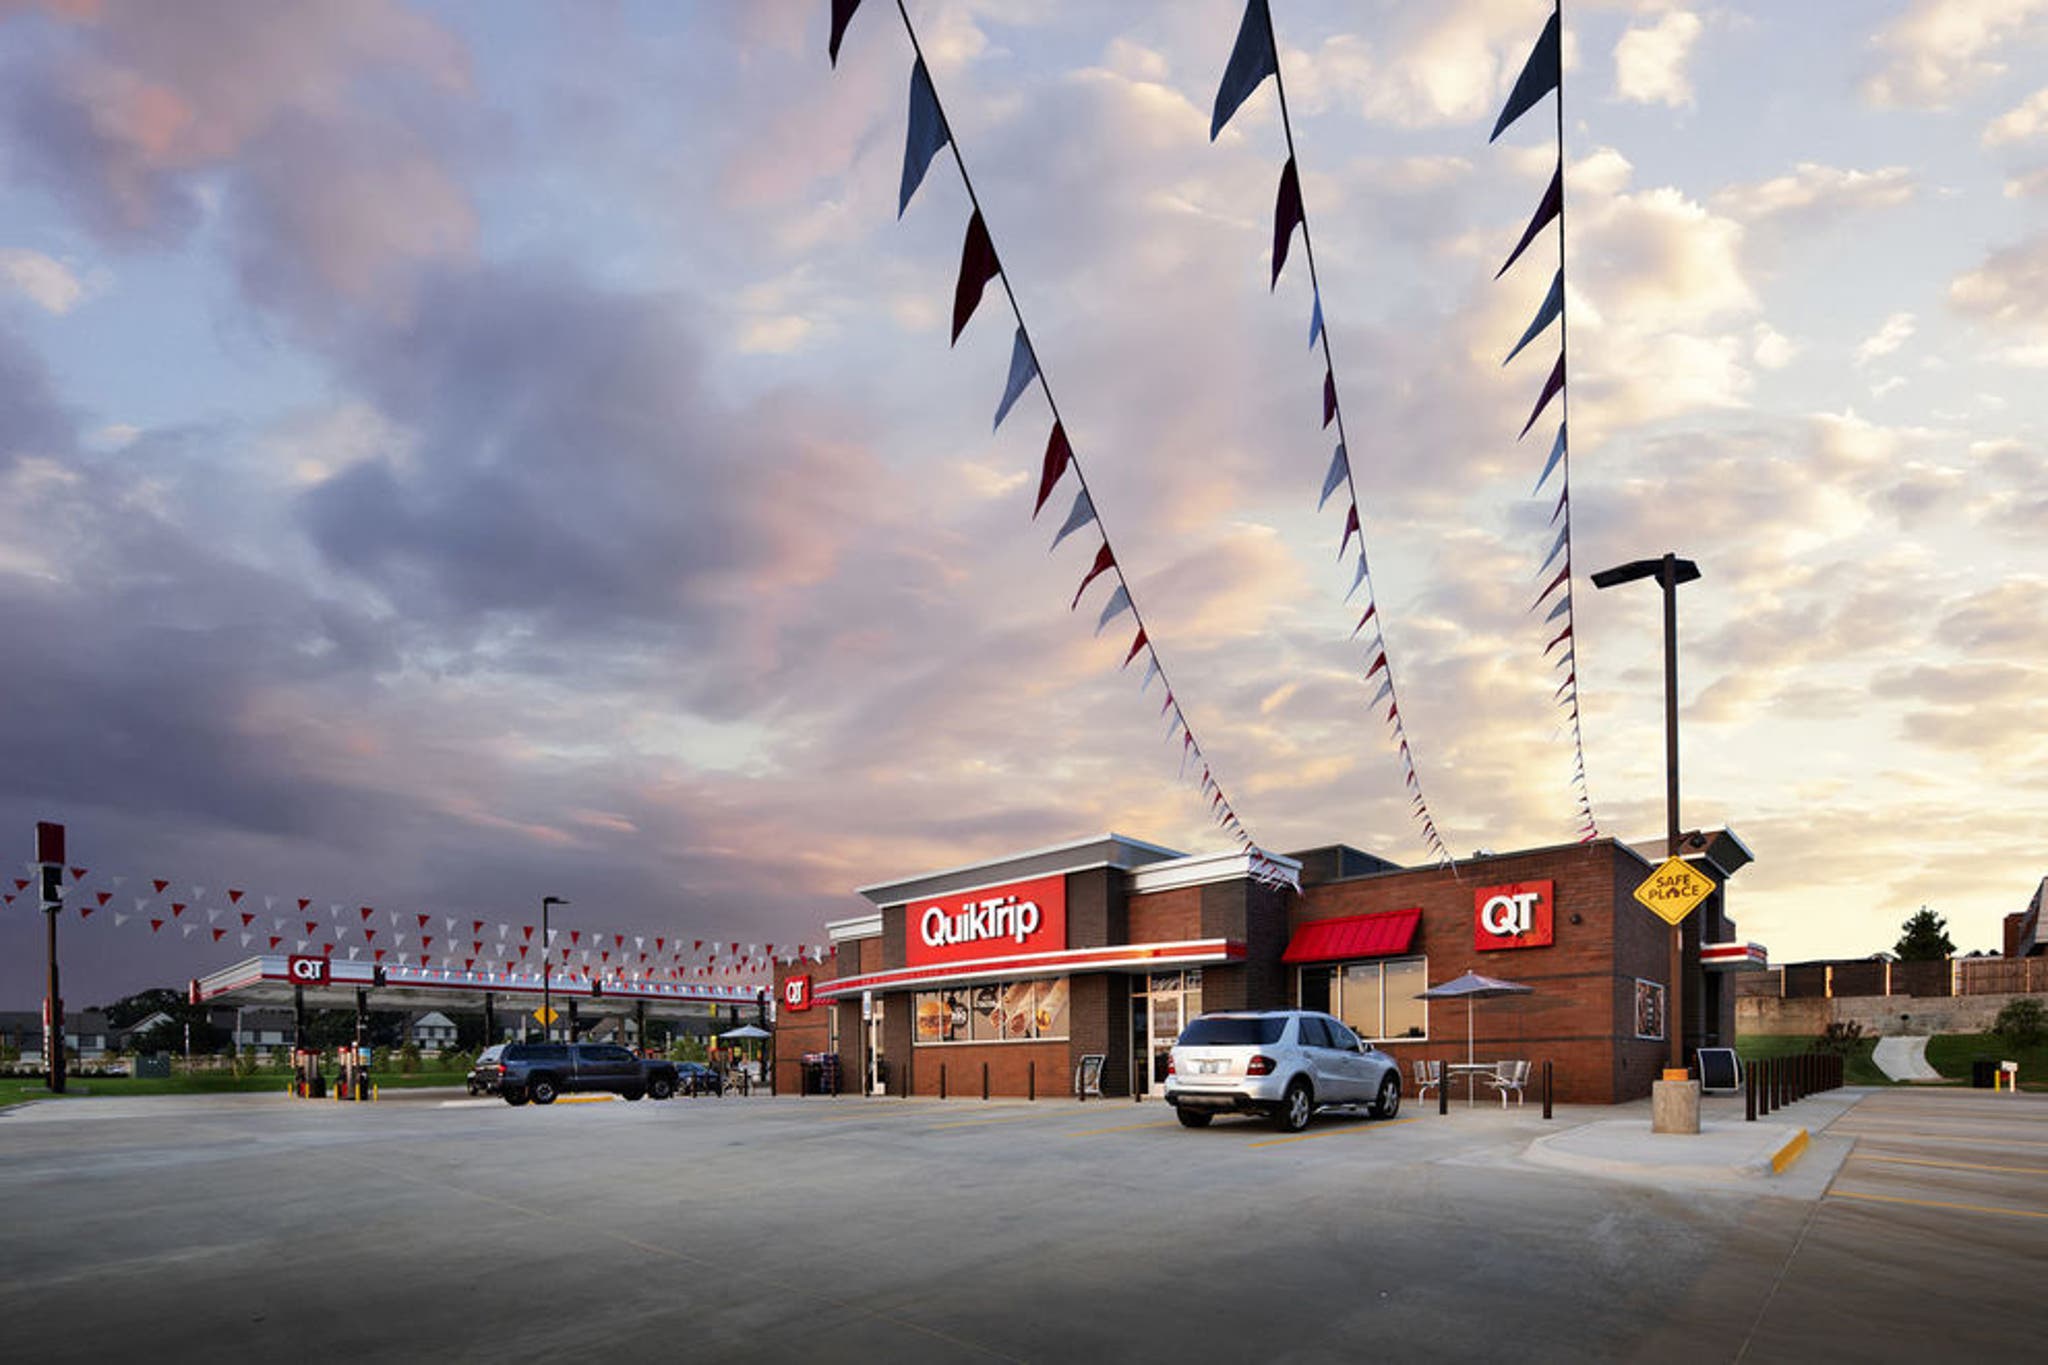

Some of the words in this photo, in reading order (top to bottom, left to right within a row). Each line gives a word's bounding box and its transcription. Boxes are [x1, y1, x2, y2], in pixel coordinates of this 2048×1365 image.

[1656, 874, 1691, 889] SAFE
[921, 896, 1040, 946] QuikTrip
[1481, 892, 1539, 935] QT
[294, 960, 324, 979] QT
[786, 980, 804, 1004] QT
